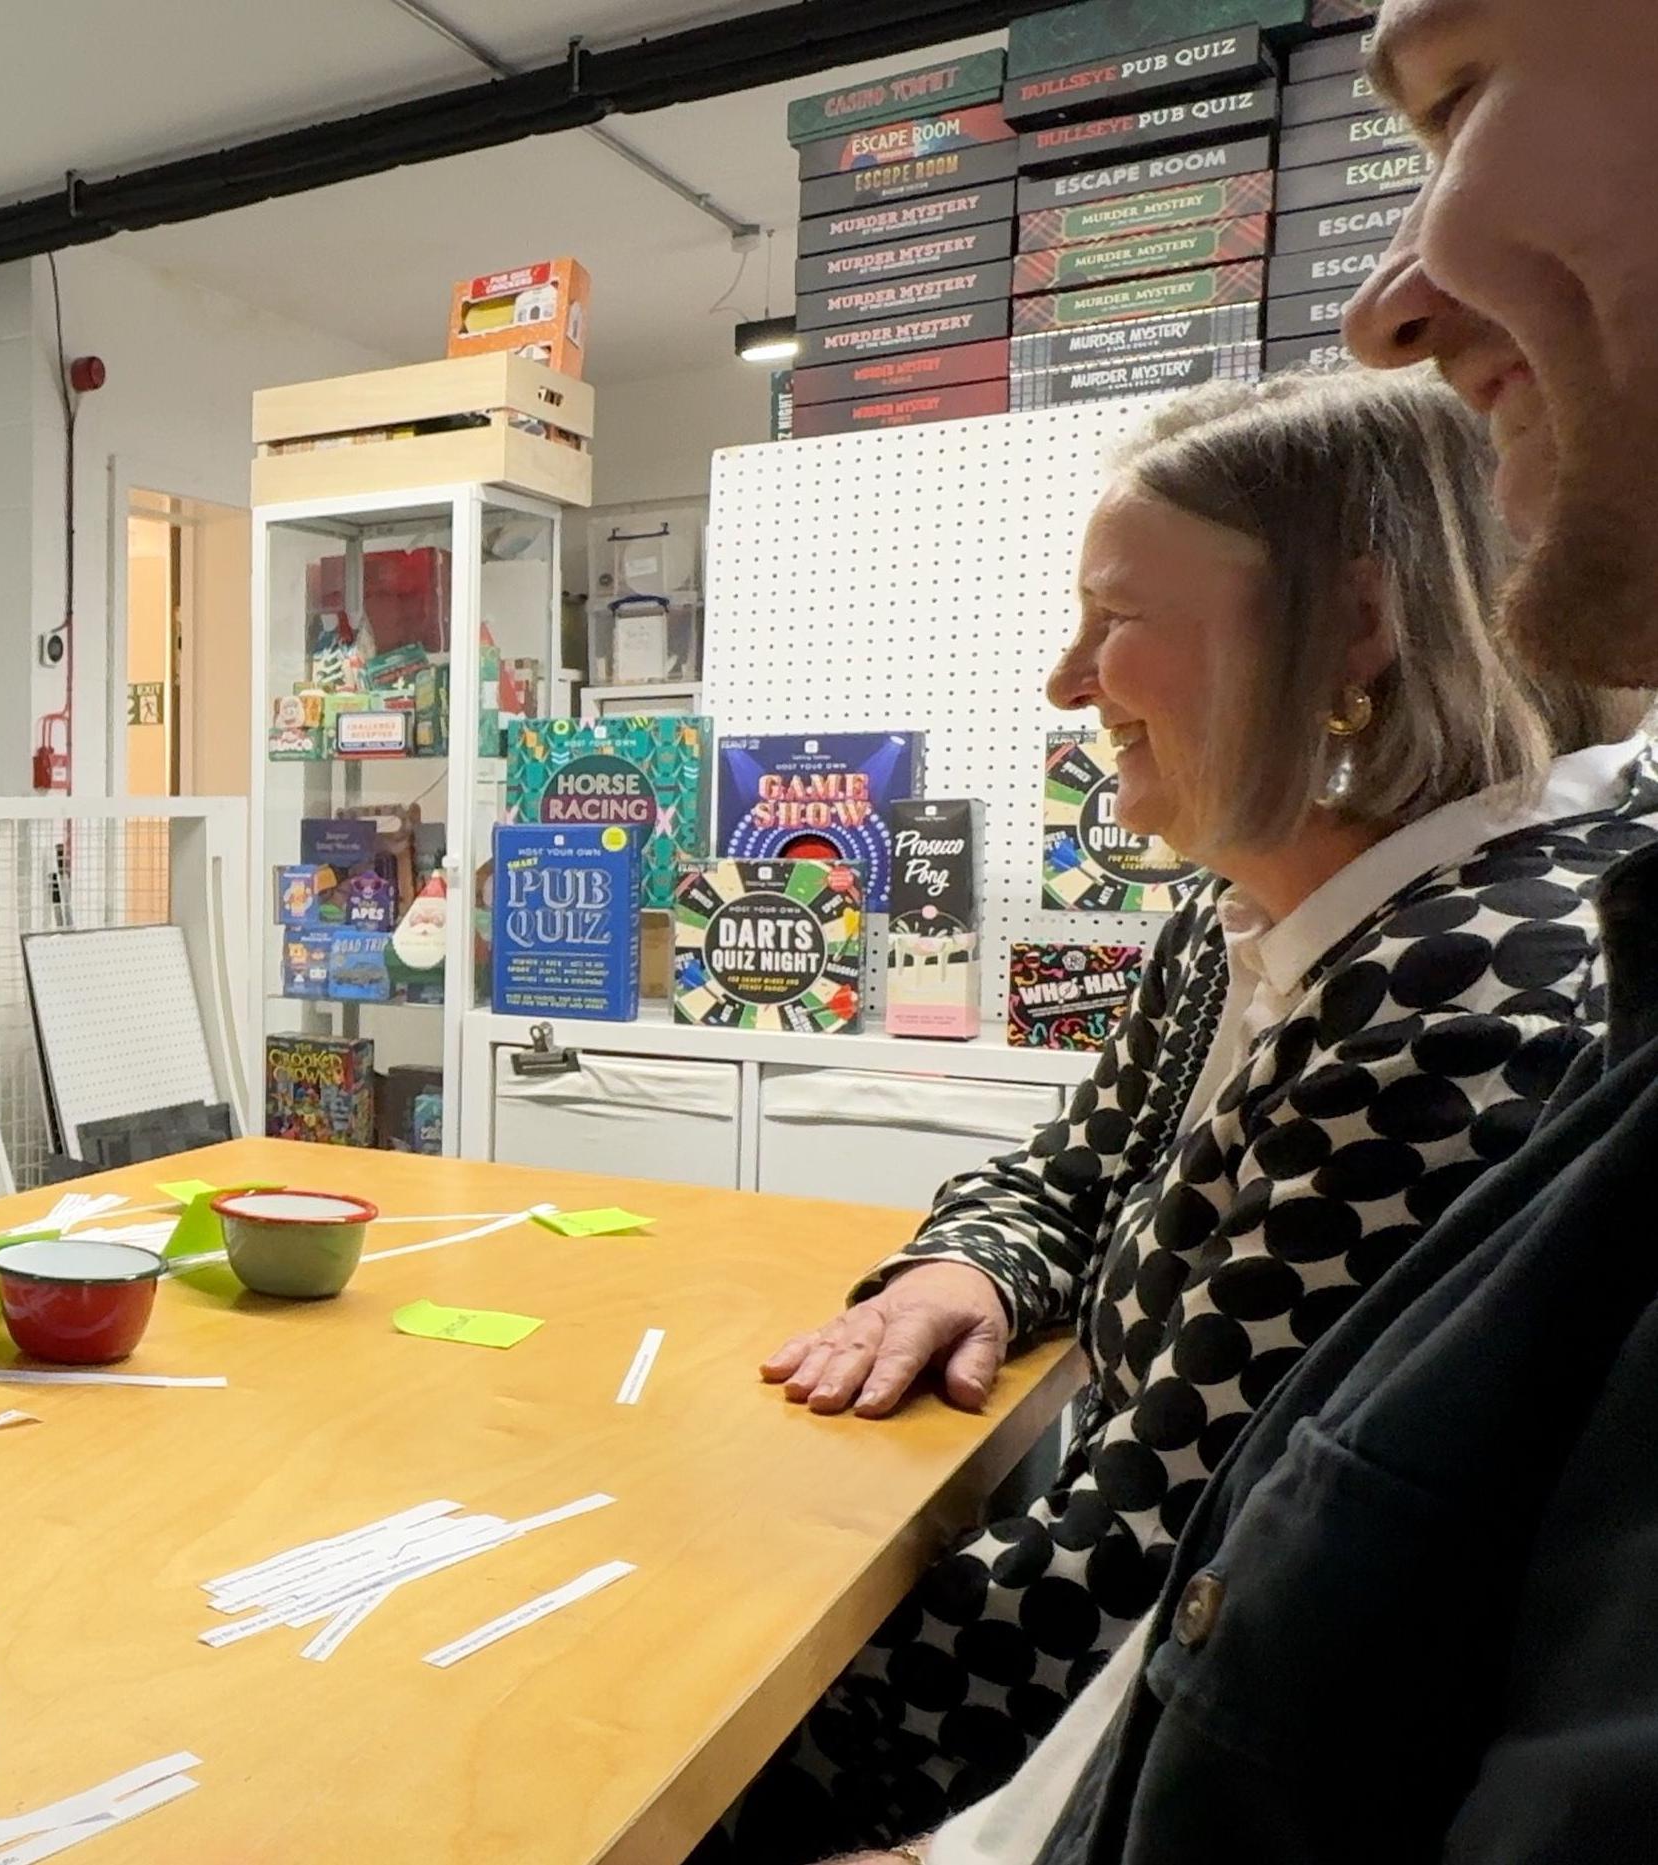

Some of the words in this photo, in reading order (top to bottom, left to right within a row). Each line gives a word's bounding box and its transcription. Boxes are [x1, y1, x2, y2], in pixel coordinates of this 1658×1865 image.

[1020, 65, 1119, 101] BULLSEYE
[1121, 54, 1168, 79] PUB
[1174, 37, 1238, 67] QUIZ
[823, 87, 885, 118] CASINO
[1036, 117, 1135, 149] BULLSEYE
[1138, 107, 1185, 130] PUB
[1191, 91, 1255, 120] QUIZ
[1349, 114, 1404, 142] ESCA
[851, 127, 908, 155] ESCAPE
[912, 118, 961, 145] ROOM
[855, 164, 911, 192] ESCAPE
[915, 154, 959, 180] ROOM
[1054, 164, 1141, 197] ESCAPE
[1149, 149, 1227, 179] ROOM
[1346, 154, 1421, 185] ESCAPE
[829, 211, 898, 236] MURDER
[902, 195, 981, 220] MYSTERY
[1081, 206, 1139, 226] MURDER
[1143, 193, 1205, 213] MYSTERY
[827, 250, 896, 275] MURDER
[900, 235, 977, 260] MYSTERY
[1074, 249, 1132, 269] MURDER
[1137, 236, 1198, 256] MYSTERY
[1311, 253, 1382, 279] ESCA
[827, 288, 896, 312] MURDER
[900, 274, 978, 299] MYSTERY
[1073, 292, 1131, 312] MURDER
[1135, 281, 1197, 300] MYSTERY
[824, 326, 892, 350] MURDER
[896, 314, 974, 339] MYSTERY
[1069, 329, 1126, 352] MURDER
[1129, 320, 1192, 342] MYSTERY
[1070, 368, 1129, 390] MURDER
[1131, 359, 1193, 381] MYSTERY
[557, 773, 641, 796] HORSE
[758, 773, 870, 801] GAME
[549, 798, 648, 821] RACING
[753, 801, 872, 829] SHOW
[547, 847, 574, 857] YOUR
[576, 848, 602, 857] OWN
[895, 829, 965, 858] Prosecco
[1089, 826, 1142, 852] QUIZ
[507, 867, 613, 910] PUB
[904, 858, 950, 897] Pong
[728, 906, 750, 914] HOST
[753, 906, 777, 914] YOUR
[506, 909, 613, 948] QUIZ
[718, 917, 814, 951] DARTS
[711, 950, 756, 973] QUIZ
[760, 951, 821, 974] NIGHT
